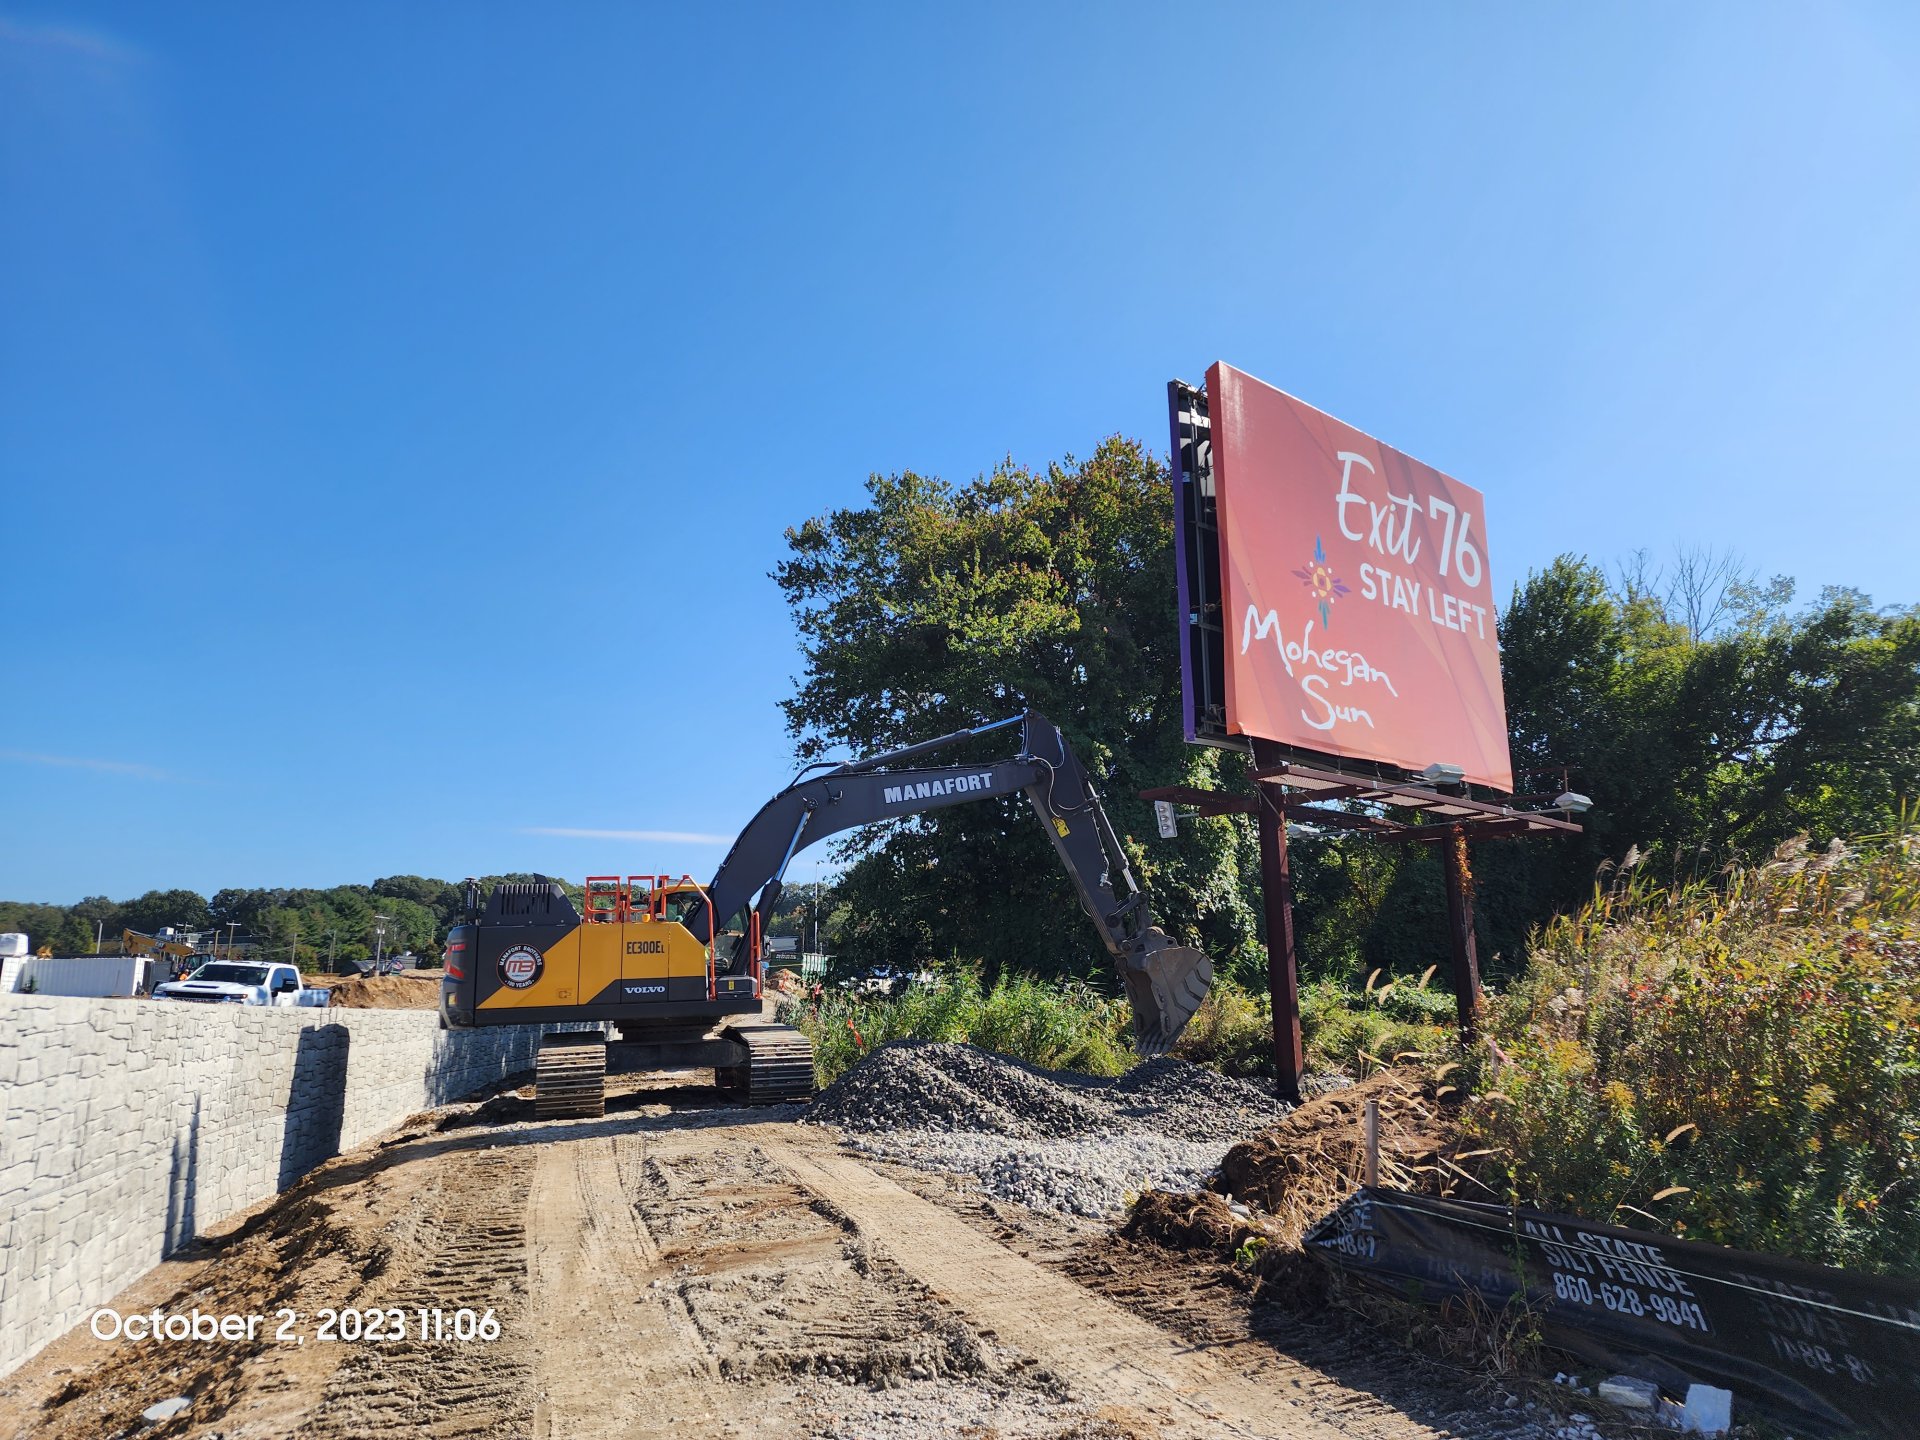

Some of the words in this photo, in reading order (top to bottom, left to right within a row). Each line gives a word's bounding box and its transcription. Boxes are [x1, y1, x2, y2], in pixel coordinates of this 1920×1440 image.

[1336, 451, 1423, 564] Exit
[1429, 495, 1482, 588] 76
[1360, 563, 1420, 616] STAY
[1428, 587, 1486, 640] LEFT
[1241, 604, 1398, 697] Mohegan
[1301, 674, 1375, 730] Sun
[883, 772, 992, 804] MANAFORT
[499, 945, 522, 966] MANAFORT
[523, 945, 543, 966] BROTHERS
[516, 979, 532, 988] YEARS
[624, 985, 666, 994] VOLVO
[1539, 1242, 1595, 1275] SILT
[1596, 1254, 1695, 1298] FENCE
[1553, 1272, 1709, 1332] 860-628-9841
